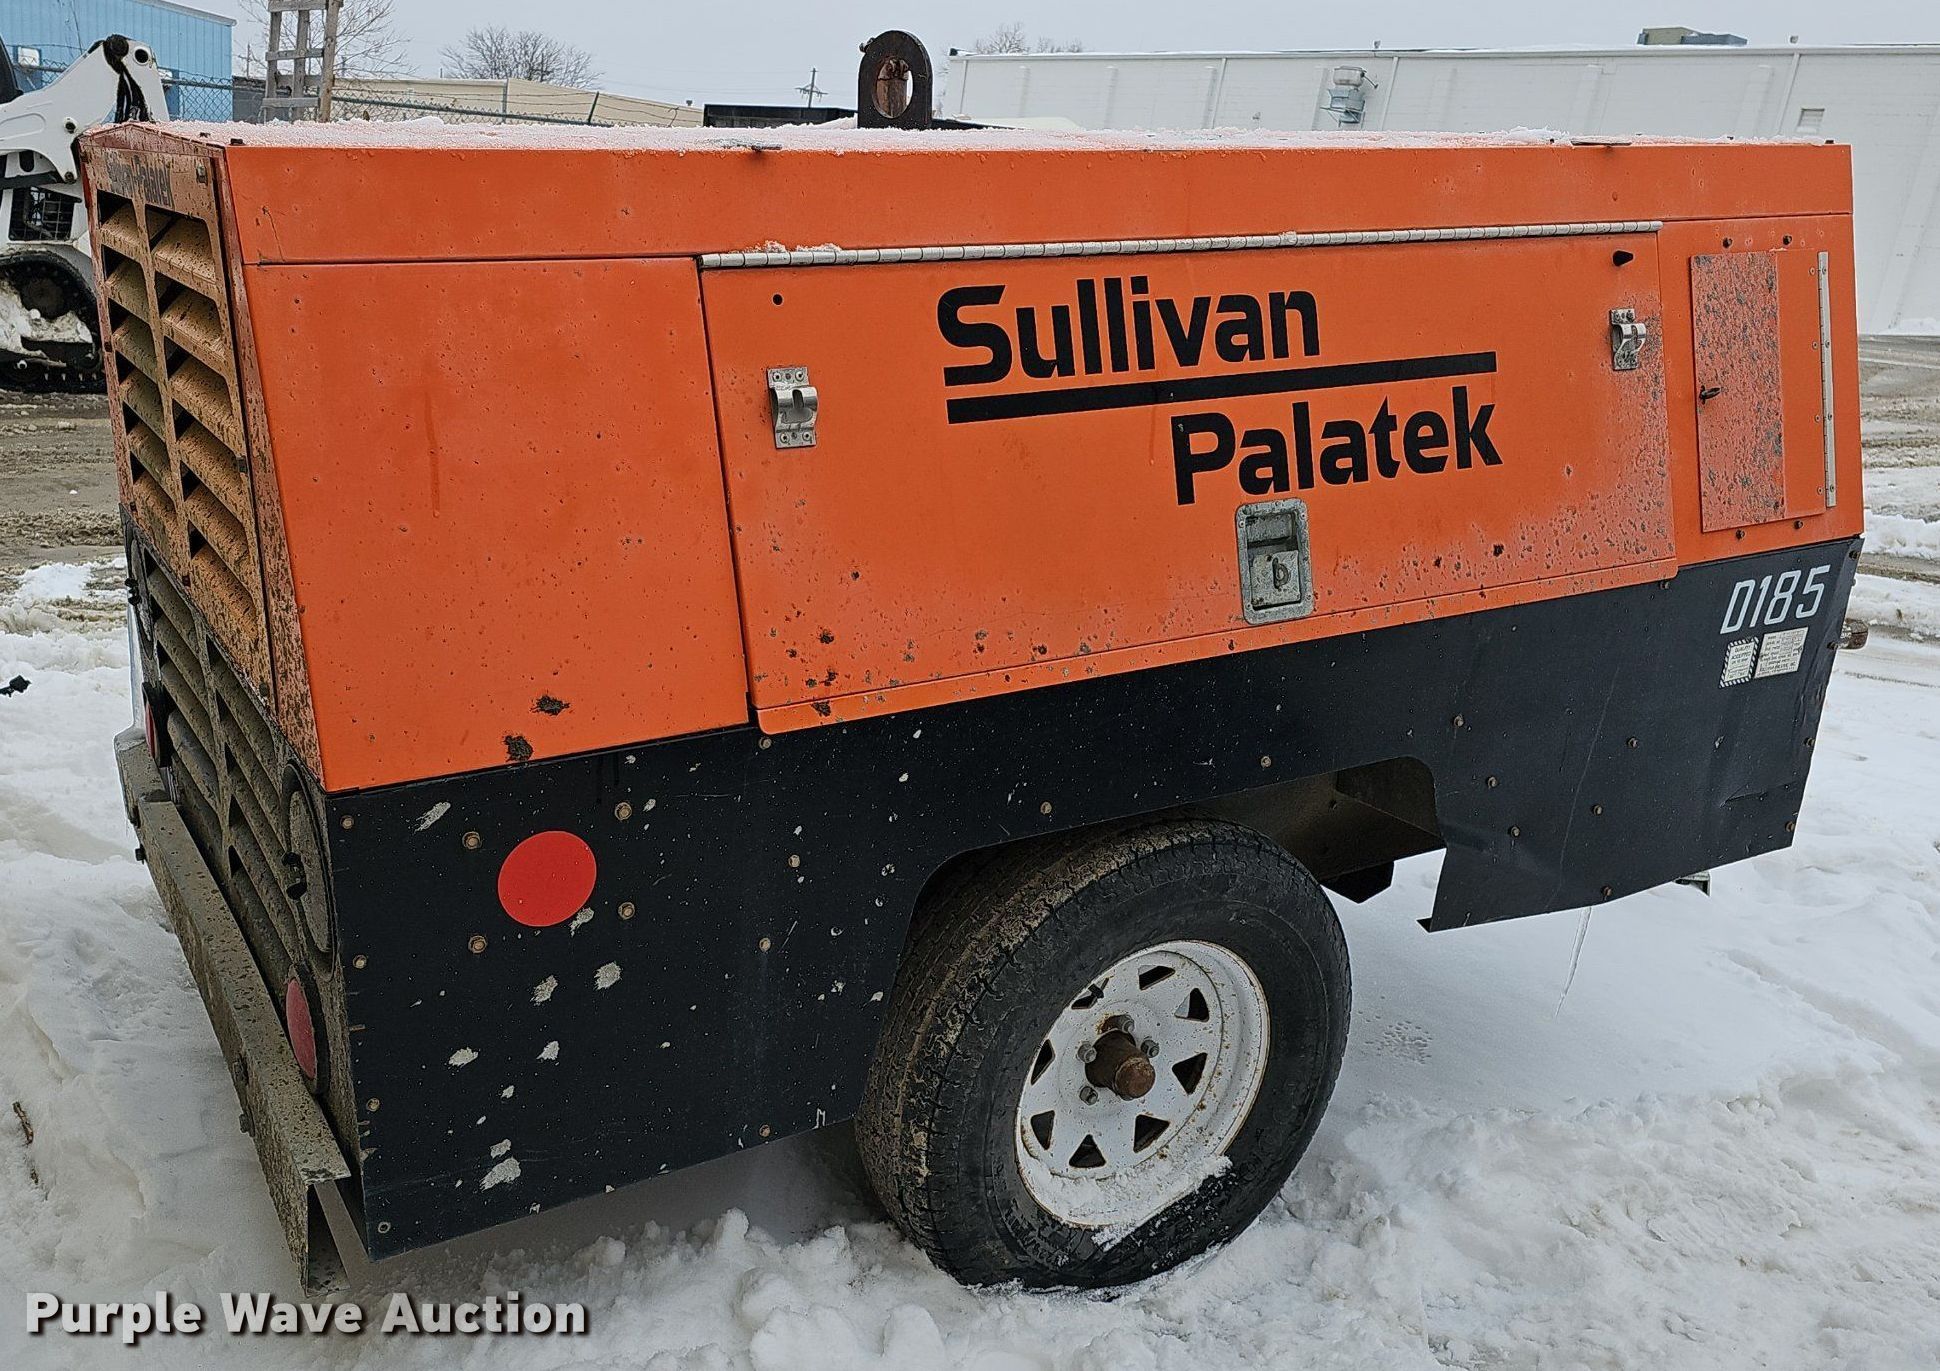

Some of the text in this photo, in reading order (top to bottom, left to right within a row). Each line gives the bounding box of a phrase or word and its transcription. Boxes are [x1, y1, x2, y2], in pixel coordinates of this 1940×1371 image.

[937, 275, 1320, 387] Sullivan
[1170, 385, 1503, 506] Palatek
[1720, 564, 1831, 635] D185
